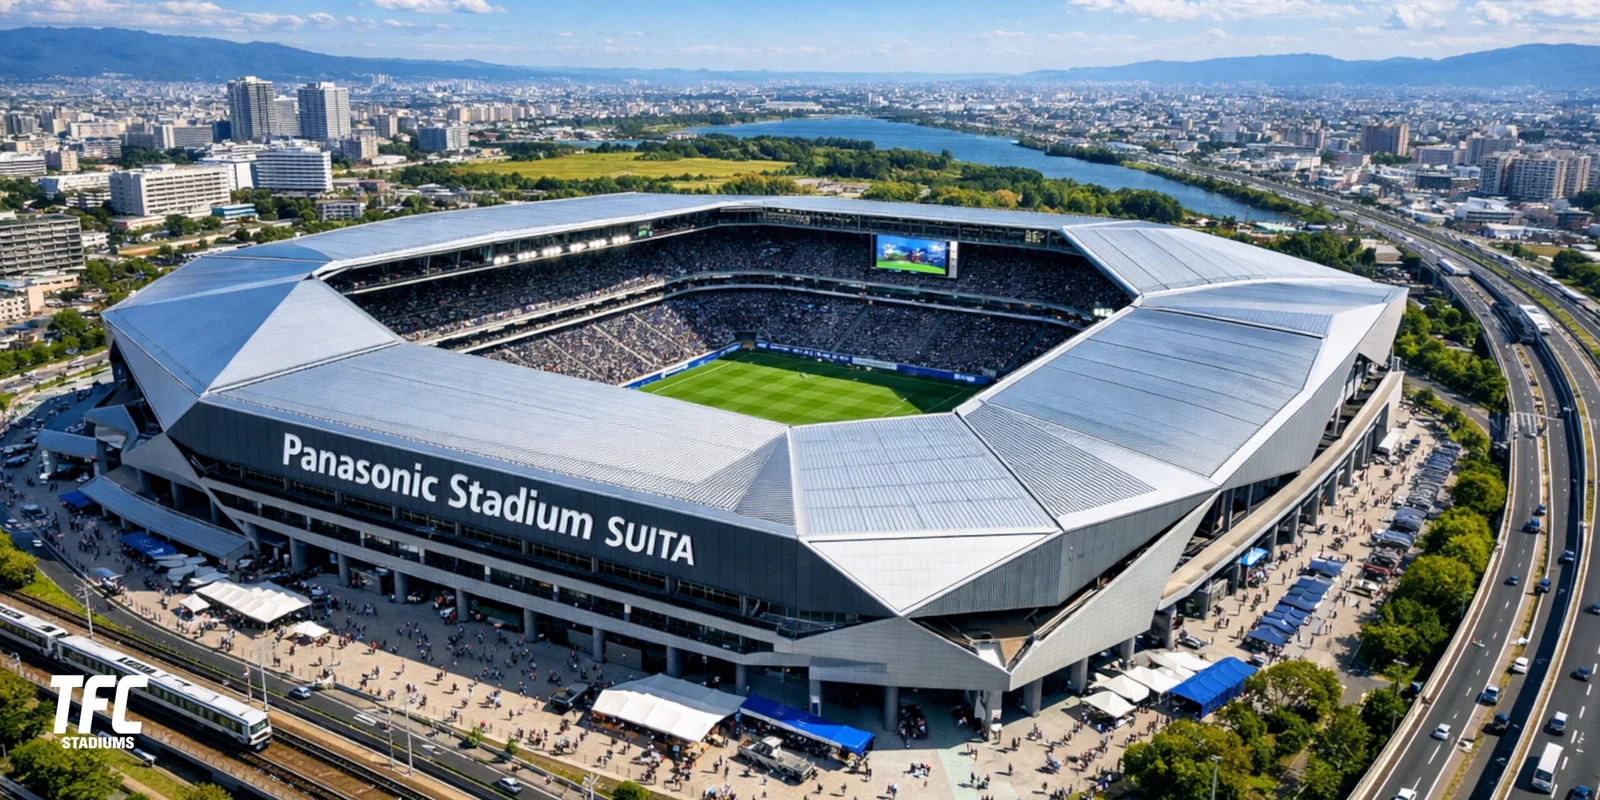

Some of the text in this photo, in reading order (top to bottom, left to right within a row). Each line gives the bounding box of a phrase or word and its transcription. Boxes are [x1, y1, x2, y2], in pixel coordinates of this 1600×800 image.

[282, 432, 695, 566] Panasonic Stadium SUITA
